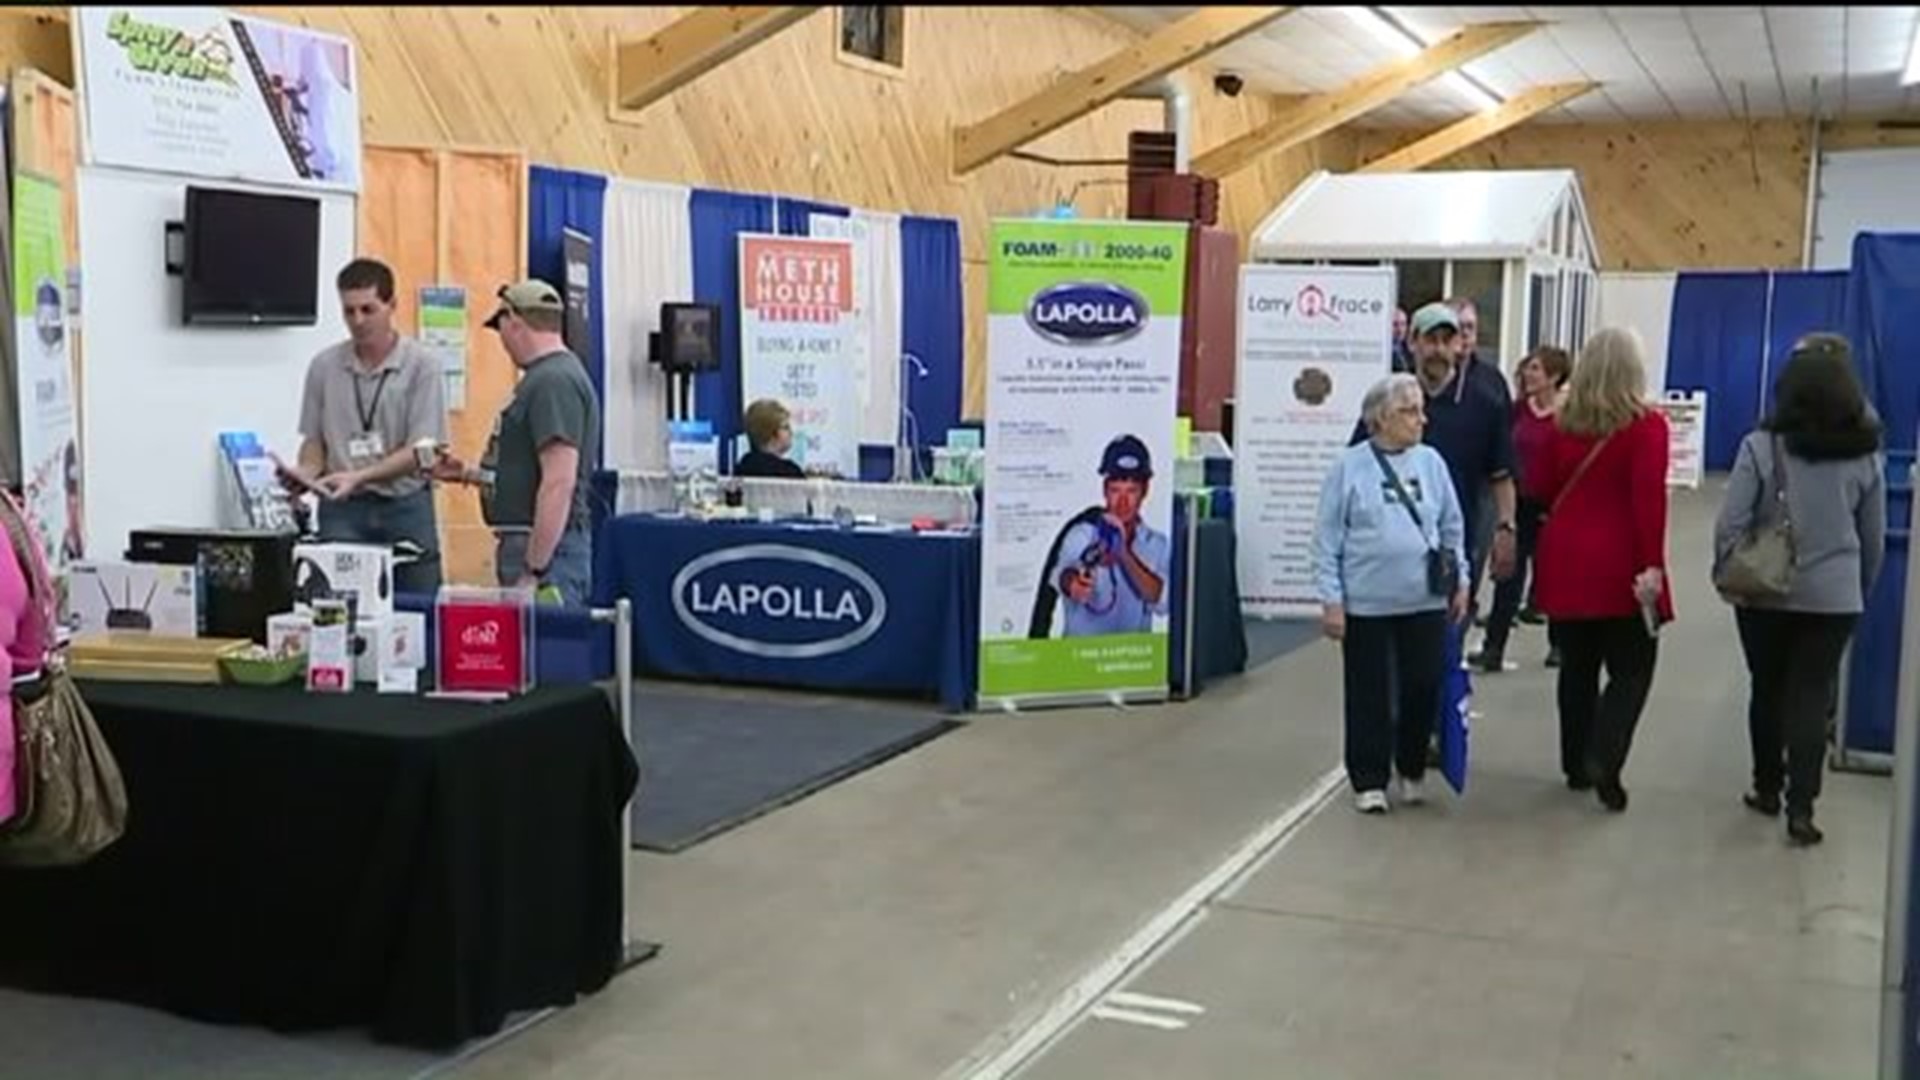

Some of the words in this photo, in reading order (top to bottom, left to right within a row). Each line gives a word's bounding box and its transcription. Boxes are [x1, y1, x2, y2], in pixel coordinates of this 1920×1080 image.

[757, 253, 840, 284] METH
[757, 284, 840, 304] HOUSE
[1036, 303, 1137, 324] LAPOLLA
[692, 581, 862, 622] LAPOLLA
